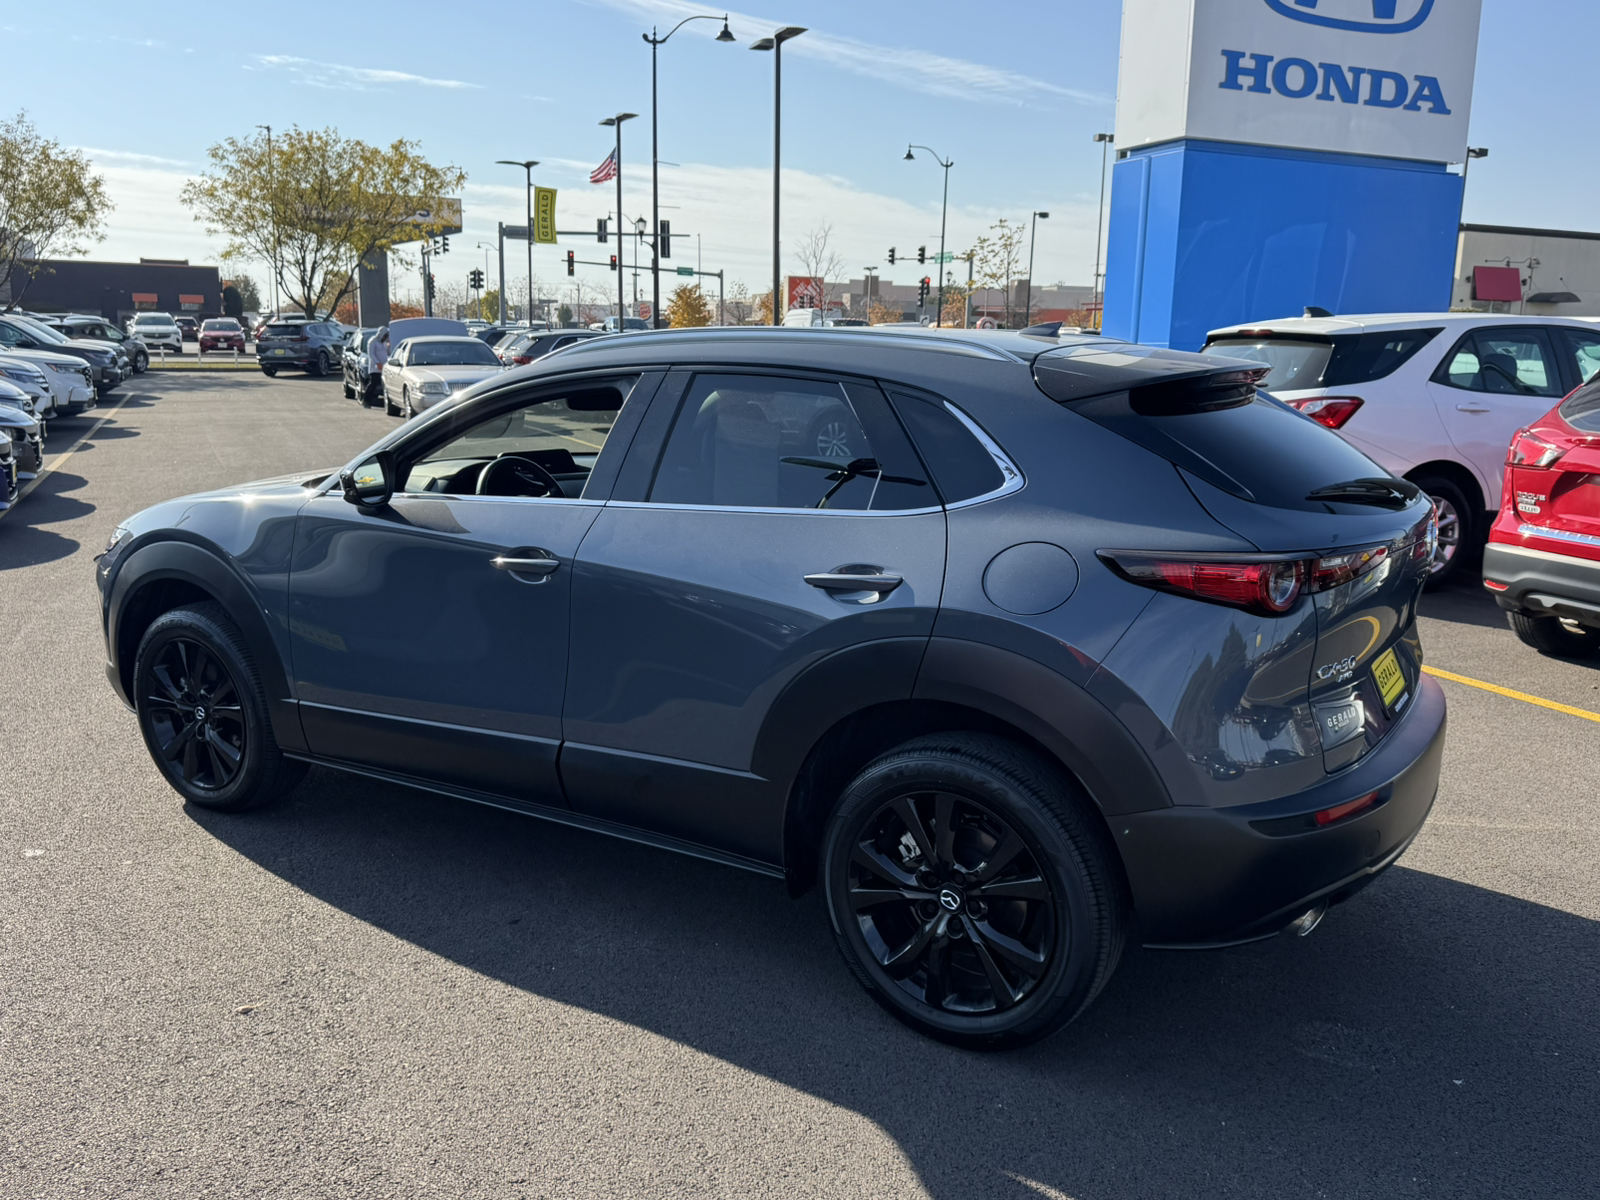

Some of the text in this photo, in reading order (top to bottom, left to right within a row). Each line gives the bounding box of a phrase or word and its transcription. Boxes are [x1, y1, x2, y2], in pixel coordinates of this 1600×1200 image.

[1218, 49, 1452, 115] HONDA
[541, 194, 549, 237] GERALD
[1316, 655, 1356, 679] CX-30
[1378, 659, 1398, 689] GERALD
[1327, 706, 1356, 727] GERALD
